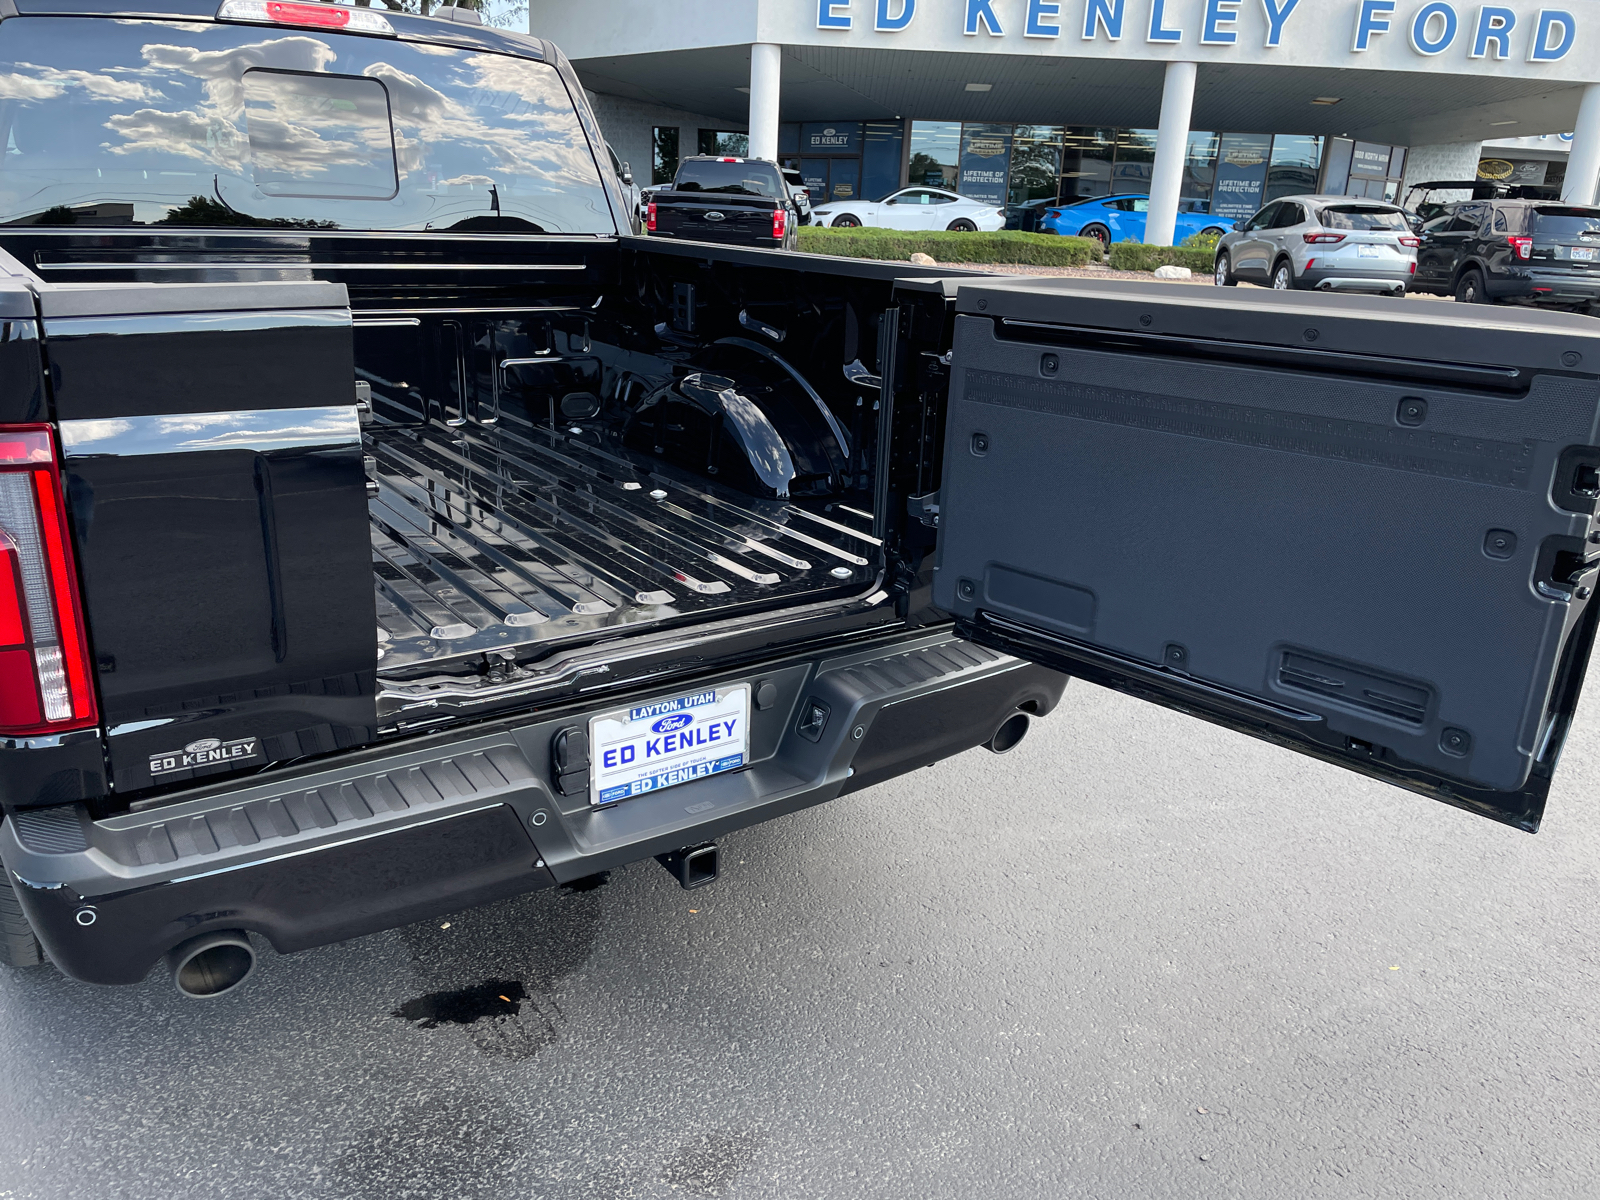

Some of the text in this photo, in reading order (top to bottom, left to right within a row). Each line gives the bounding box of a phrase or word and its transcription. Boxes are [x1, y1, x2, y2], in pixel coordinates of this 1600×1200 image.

[816, 0, 1578, 63] ED KENLEY FORD
[810, 136, 848, 145] ED KENLEY
[963, 176, 1004, 184] PROTECTION
[1219, 179, 1250, 187] LIFETIME
[1218, 185, 1260, 193] PROTECTION
[632, 692, 714, 720] LAYTON, UTAH
[658, 716, 686, 733] Ford
[192, 742, 212, 752] Ford
[603, 718, 738, 769] ED KENLEY
[150, 742, 255, 772] ED KENLEY
[649, 766, 669, 775] SOFTER
[631, 778, 653, 795] ED
[657, 761, 716, 788] KENLEY
